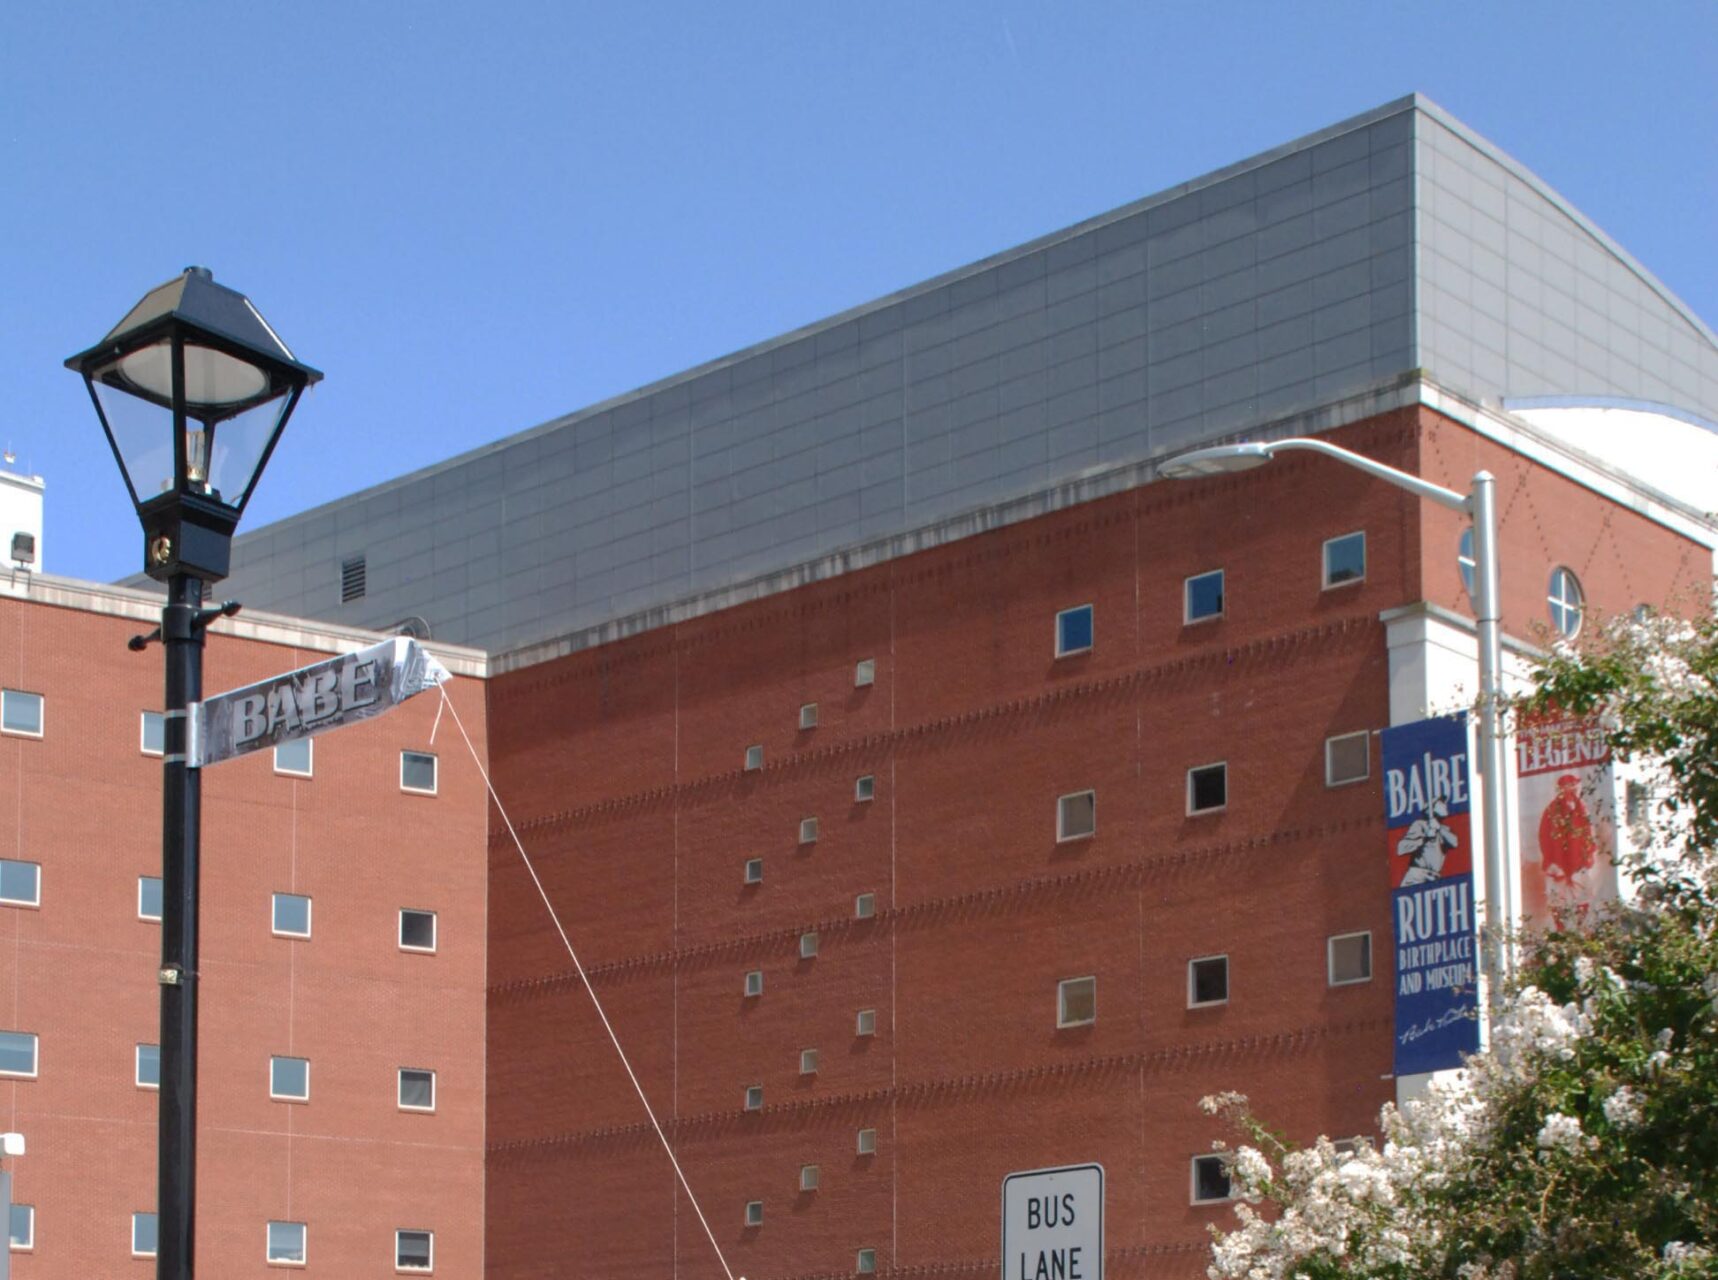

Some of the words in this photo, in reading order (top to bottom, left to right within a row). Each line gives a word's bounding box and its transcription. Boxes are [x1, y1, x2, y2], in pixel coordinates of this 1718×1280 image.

[235, 659, 376, 747] BABE
[1387, 754, 1468, 818] BABE
[1398, 882, 1470, 944] RUTH
[1399, 936, 1471, 971] BIRTHPLACE
[1399, 971, 1422, 995] AND
[1426, 962, 1472, 991] MUSEUM
[1027, 1193, 1075, 1230] BUS
